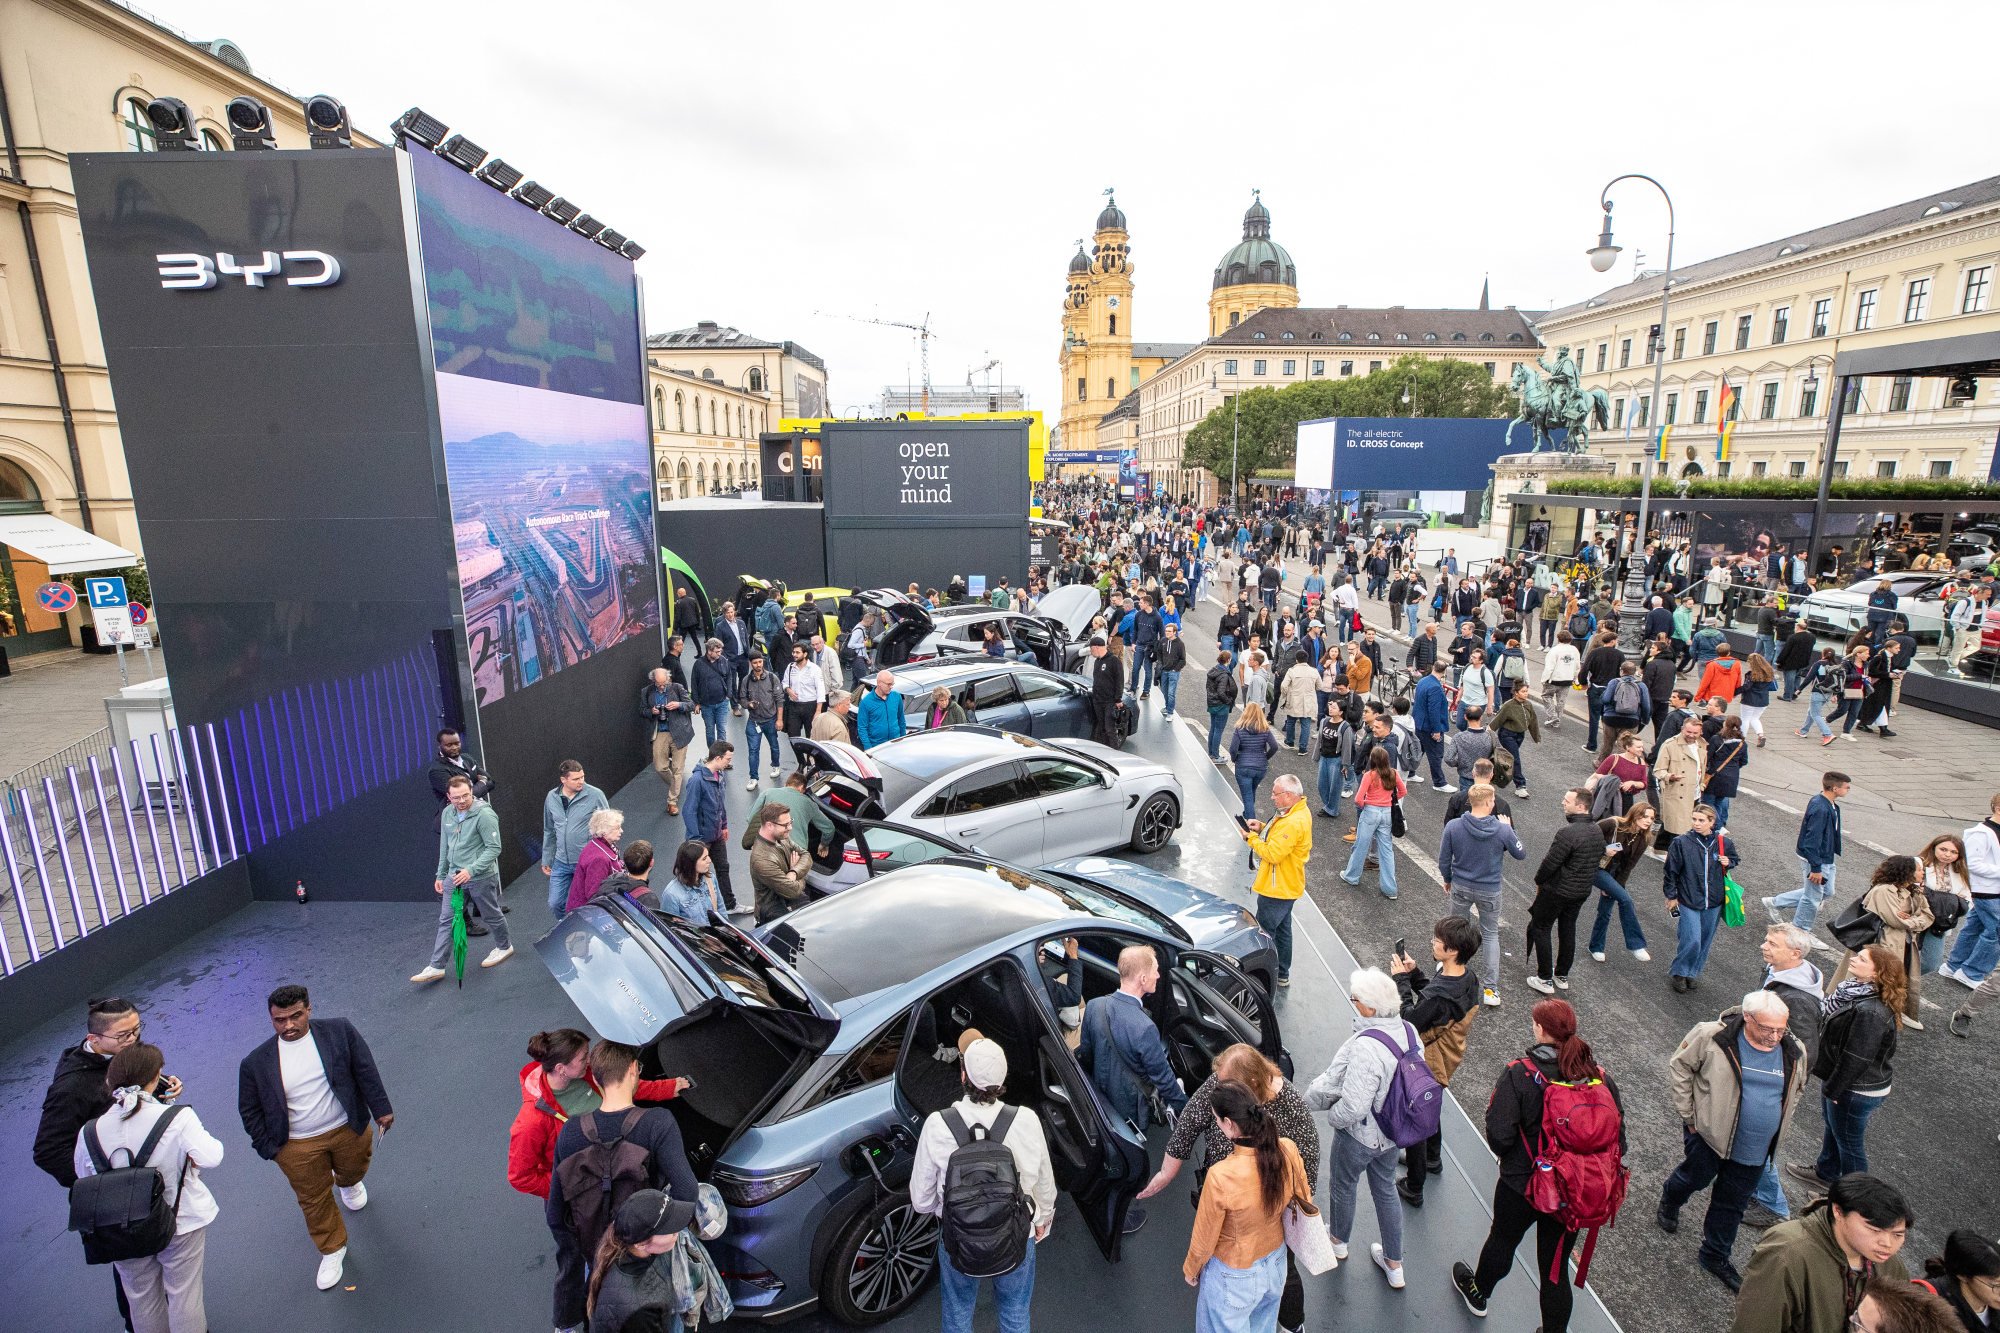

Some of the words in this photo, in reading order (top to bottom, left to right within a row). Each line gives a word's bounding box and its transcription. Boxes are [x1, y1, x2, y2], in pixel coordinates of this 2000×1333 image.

[156, 250, 341, 290] BYD
[1347, 429, 1362, 438] The
[899, 442, 950, 463] open
[1346, 439, 1358, 448] ID.
[1360, 439, 1388, 448] CROSS
[1390, 439, 1424, 450] Concept
[900, 464, 950, 485] your
[900, 484, 952, 503] mind
[526, 515, 561, 528] Autonomous
[561, 513, 574, 523] Race
[574, 511, 588, 520] Track
[588, 509, 611, 520] Challenge
[92, 581, 114, 605] P
[627, 990, 652, 1018] SEALION
[651, 1015, 657, 1023] 7
